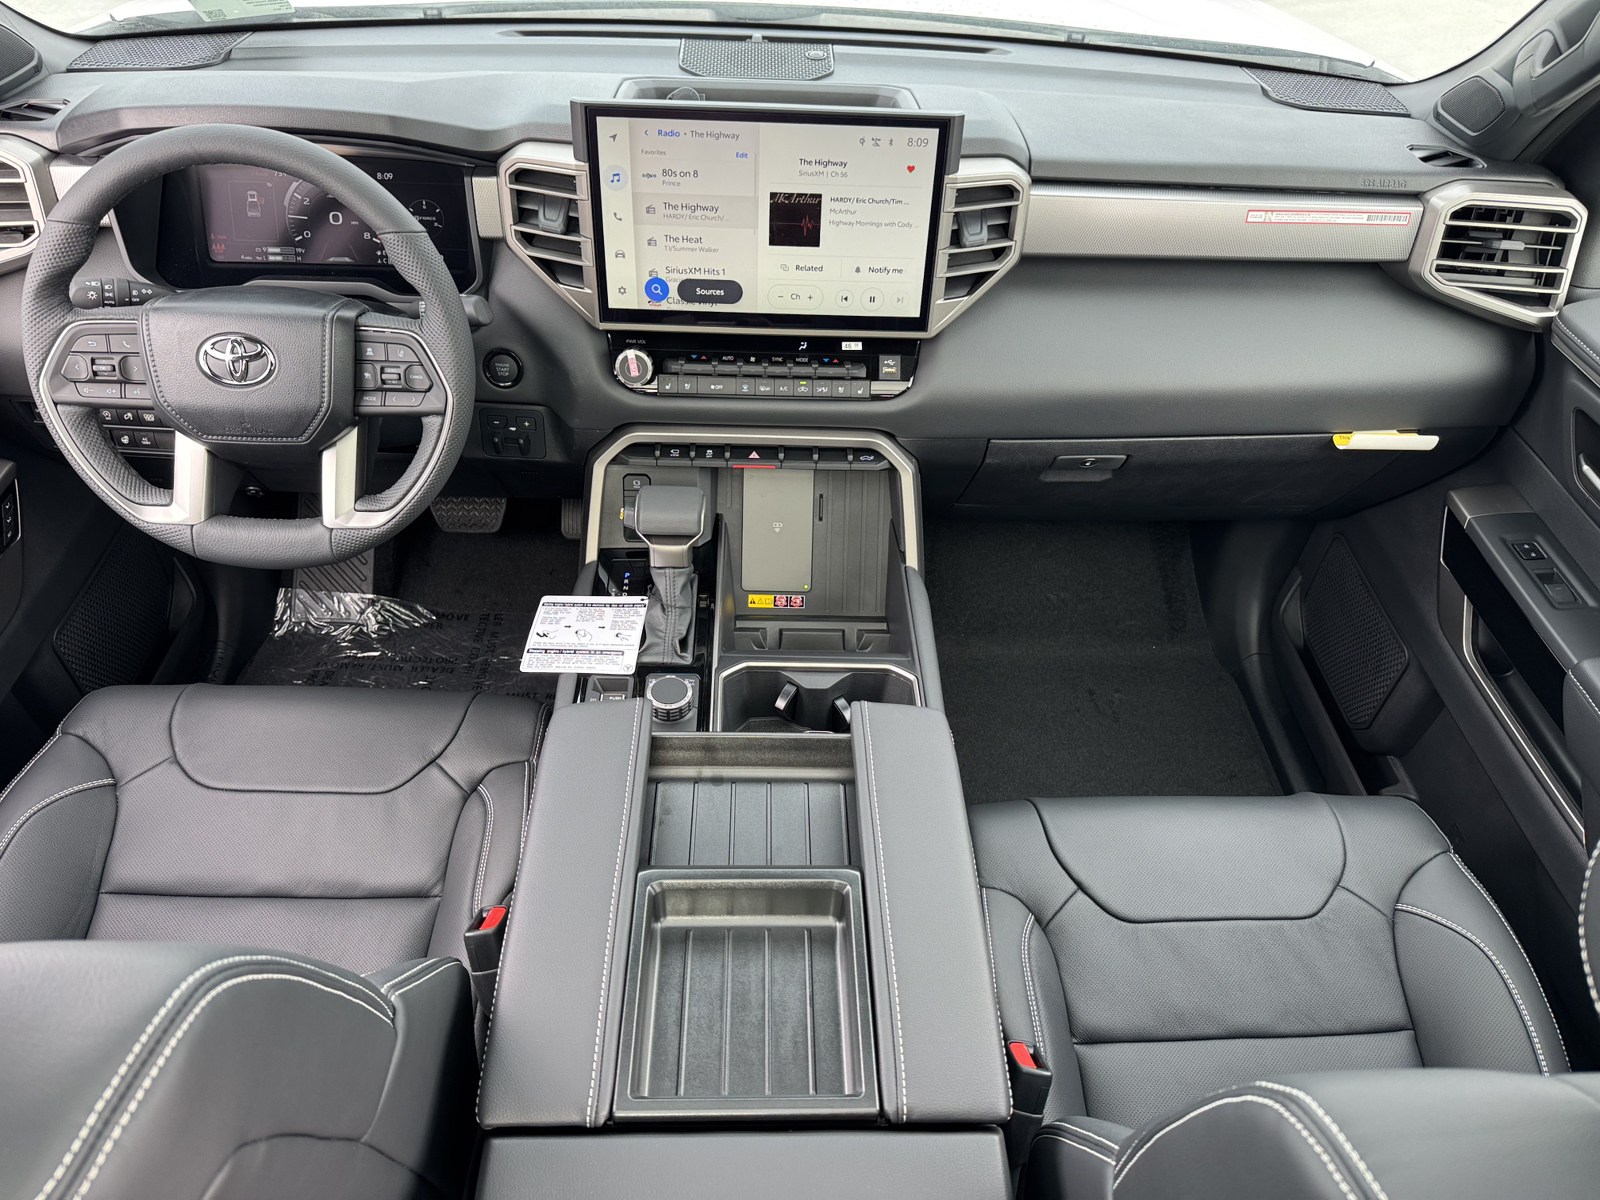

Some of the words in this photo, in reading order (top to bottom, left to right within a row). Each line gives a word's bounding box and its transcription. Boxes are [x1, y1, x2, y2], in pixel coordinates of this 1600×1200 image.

[657, 129, 680, 137] Radio
[690, 130, 705, 138] The
[705, 131, 740, 141] Highway
[907, 137, 929, 148] 8:09
[799, 158, 814, 167] The
[814, 158, 848, 169] Highway
[376, 172, 394, 180] 8:09
[661, 168, 678, 178] 80s
[679, 170, 691, 178] on
[692, 169, 699, 178] 8
[798, 170, 825, 178] SiriusXM
[1360, 178, 1374, 187] SRS
[1375, 178, 1407, 189] AIRBAG
[303, 197, 310, 205] 2
[663, 202, 680, 211] The
[680, 202, 719, 214] Highway
[328, 211, 343, 225] 0
[829, 219, 855, 228] Highway
[855, 220, 883, 229] Mornings
[897, 221, 913, 230] Cody
[303, 230, 311, 238] 0
[363, 232, 371, 240] 8
[664, 235, 680, 244] The
[681, 235, 703, 245] Heat
[698, 246, 719, 254] Walker
[665, 266, 702, 275] SiriusXM
[703, 267, 720, 276] Hits
[722, 268, 726, 276] 1
[795, 264, 824, 272] Related
[868, 266, 891, 275] Notify
[695, 287, 725, 296] Sources
[790, 293, 801, 301] Ch
[624, 571, 631, 579] P
[312, 661, 365, 670] REMOVE
[370, 663, 404, 672] MUST
[411, 665, 455, 674] DEALER
